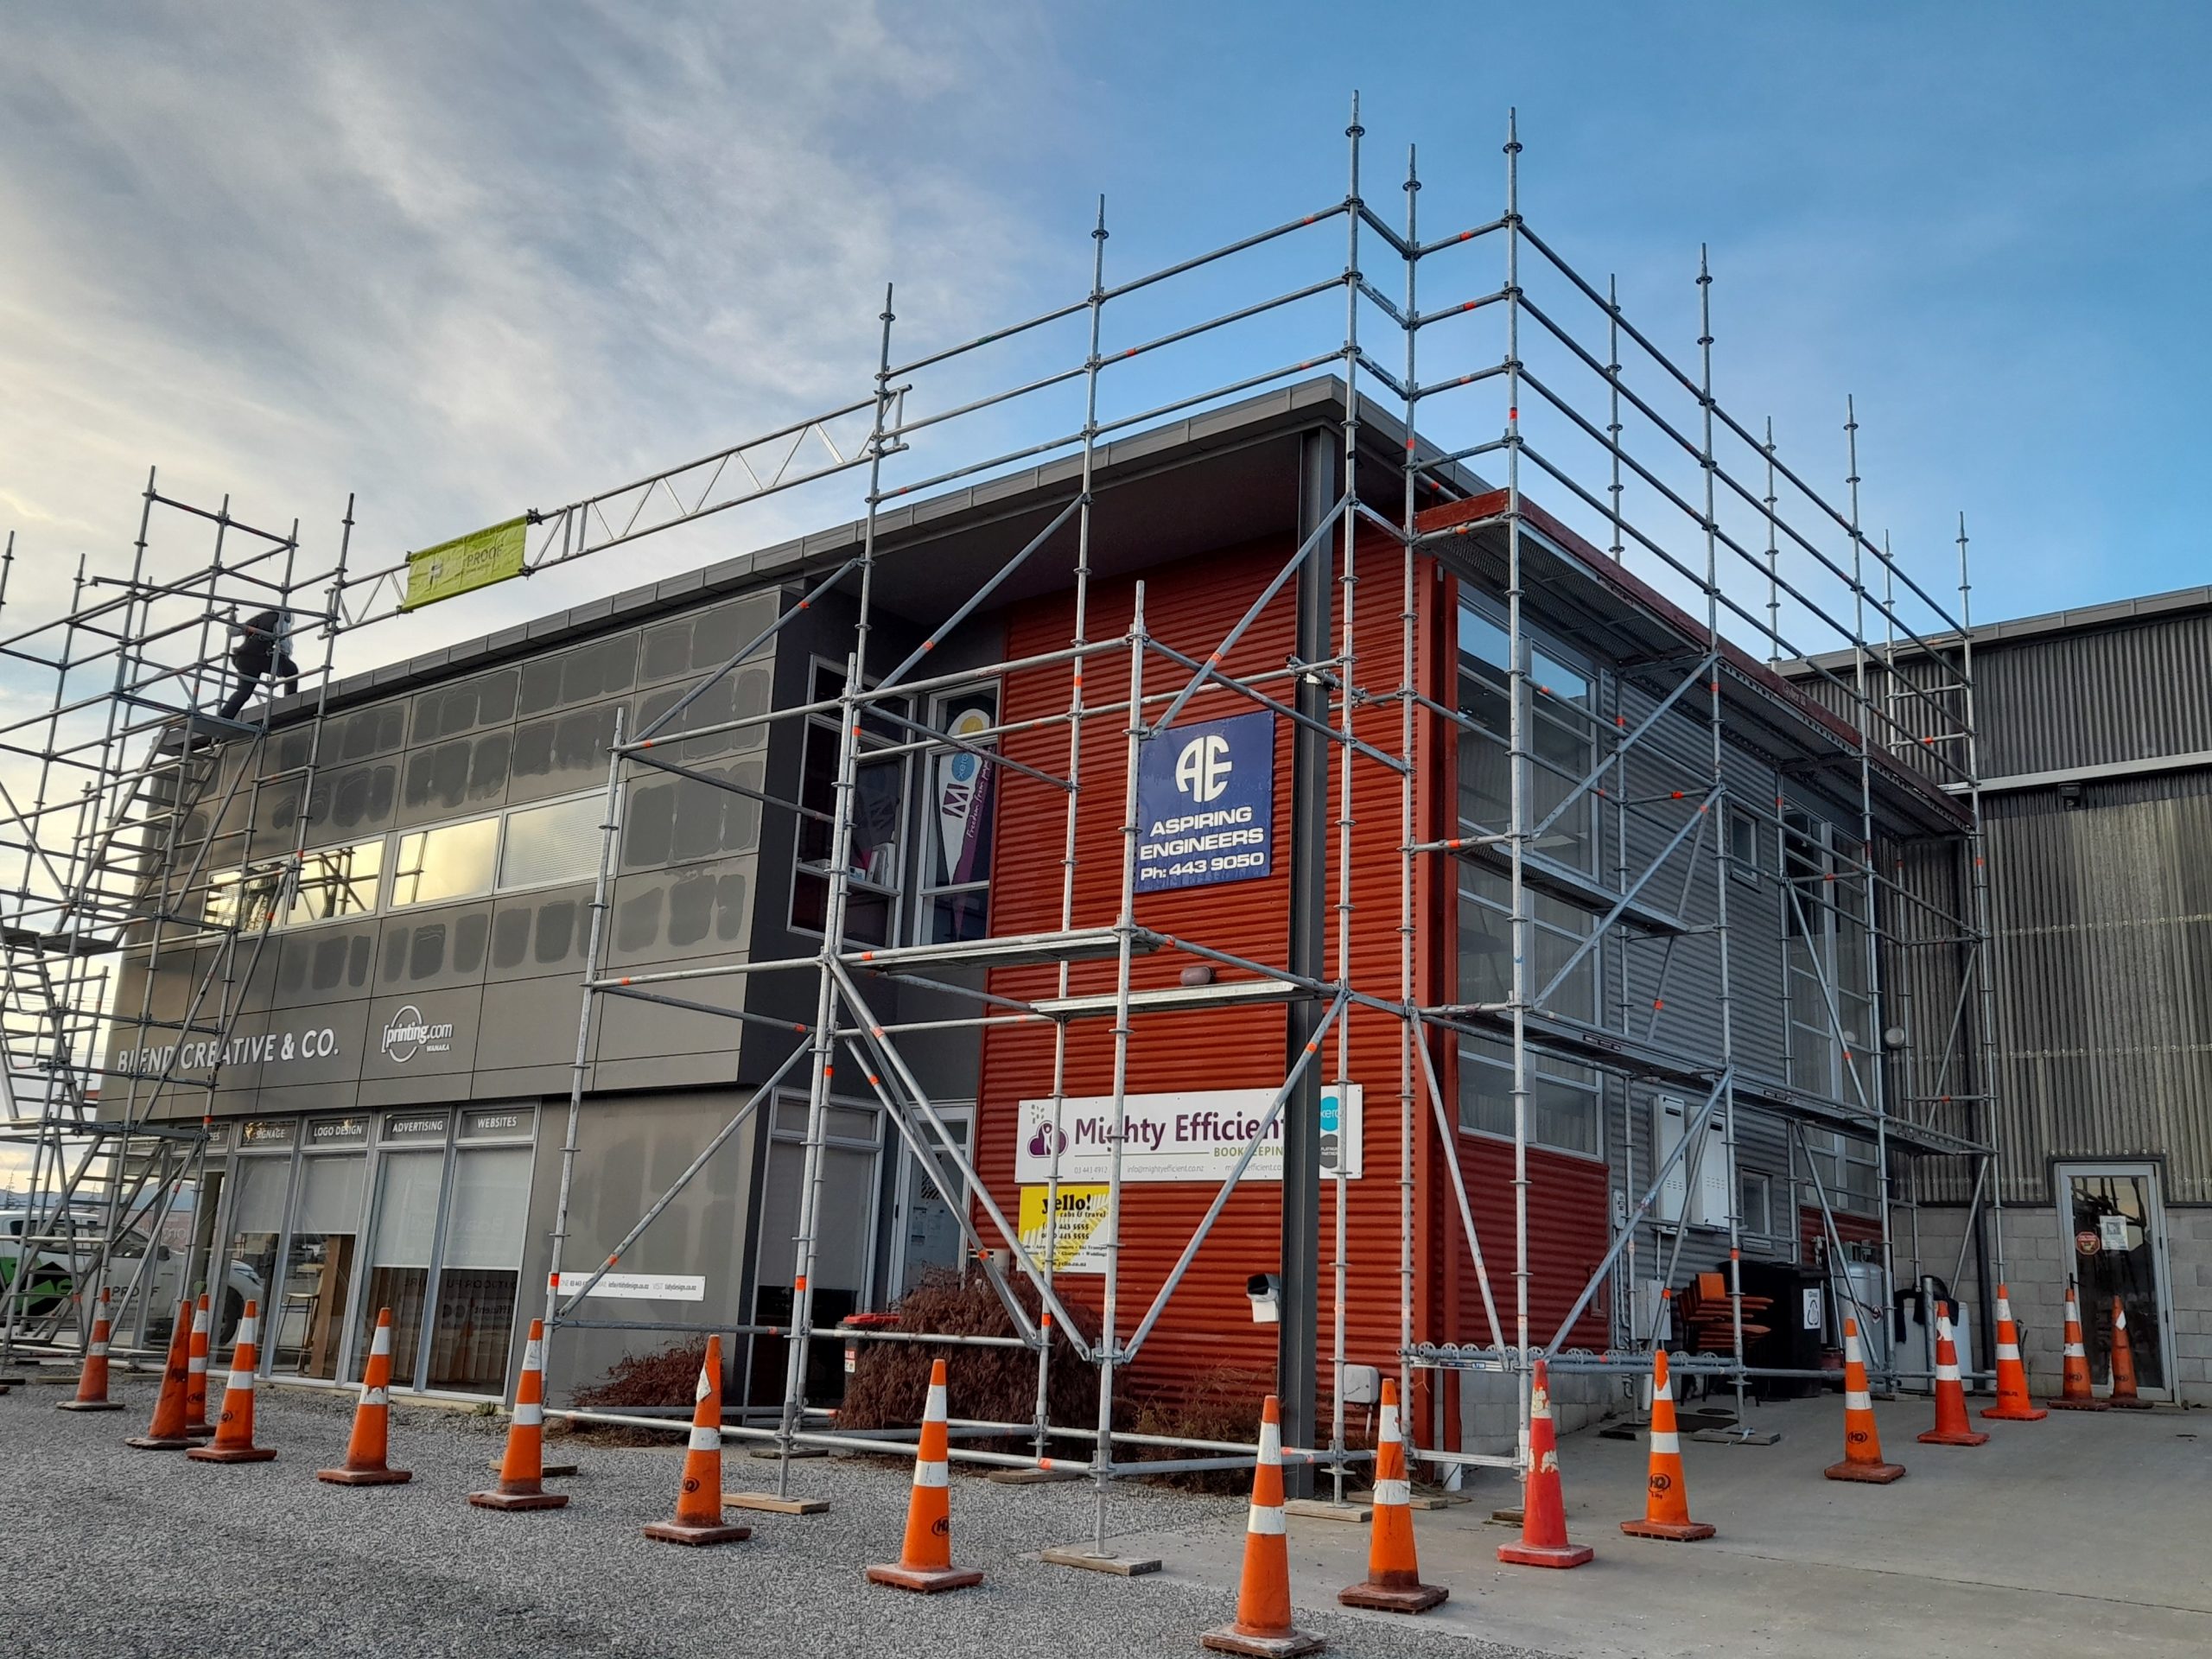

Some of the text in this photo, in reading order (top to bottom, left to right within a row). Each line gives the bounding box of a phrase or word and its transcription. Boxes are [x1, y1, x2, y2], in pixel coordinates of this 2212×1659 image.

[1149, 806, 1252, 837] ASPIRING
[1140, 828, 1264, 861] ENGINEERS
[1141, 852, 1264, 881] Ph: 443 9050
[385, 1021, 453, 1045] printing.com
[117, 1028, 340, 1073] BLEND CREATIVE & CO.
[426, 1043, 450, 1052] WANAKA
[392, 1121, 443, 1133] ADVERTISING
[477, 1116, 517, 1128] WEBSITES
[256, 1128, 286, 1140] SIGNAGE
[314, 1125, 362, 1136] LOGO DESIGN
[1214, 1146, 1283, 1158] BOOKEEPIN
[1083, 1166, 1093, 1174] 443
